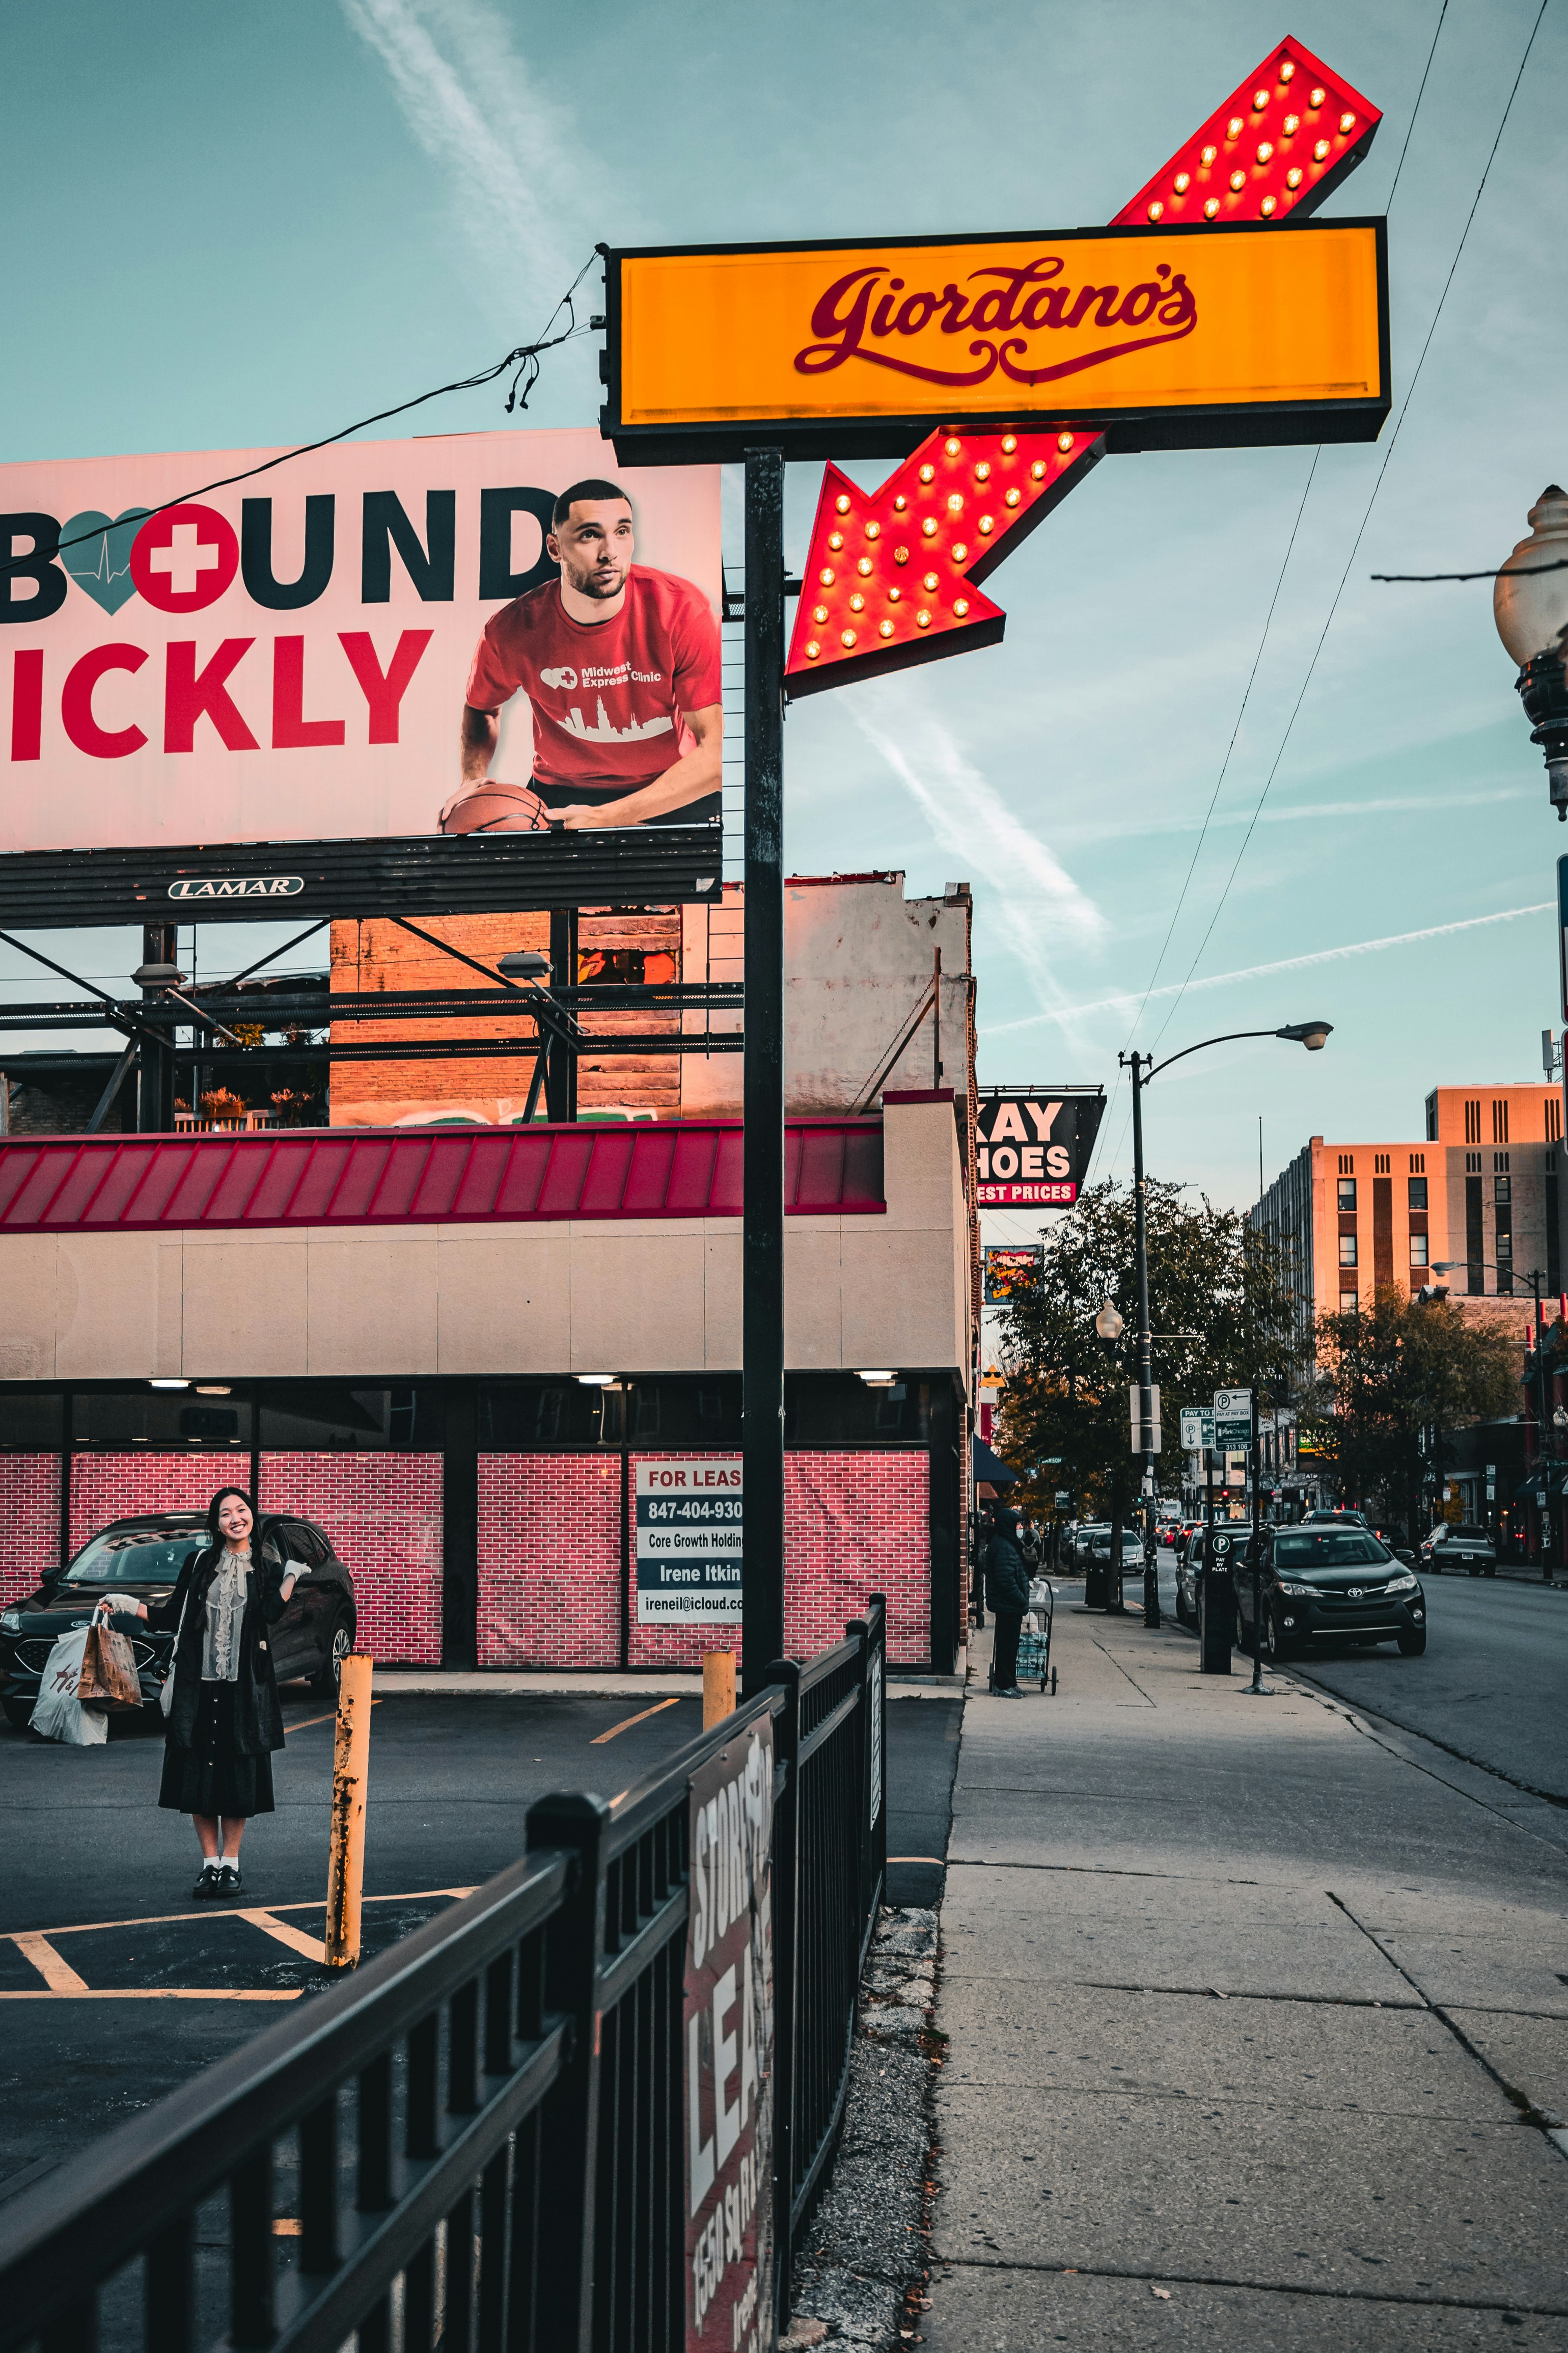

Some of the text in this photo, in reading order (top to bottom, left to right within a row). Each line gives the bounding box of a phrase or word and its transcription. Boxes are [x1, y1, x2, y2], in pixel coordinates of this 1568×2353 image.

[794, 256, 1197, 386] Giordano's
[582, 661, 631, 679] Midwest
[583, 671, 662, 689] Express Clinic
[11, 629, 434, 762] ICKLY
[179, 879, 291, 897] LAMAR
[1012, 1185, 1071, 1200] PRICES
[649, 1470, 741, 1487] FOR LEAS
[649, 1533, 671, 1548] Core
[674, 1533, 708, 1548] Growth
[661, 1564, 740, 1582] Irene Itkin
